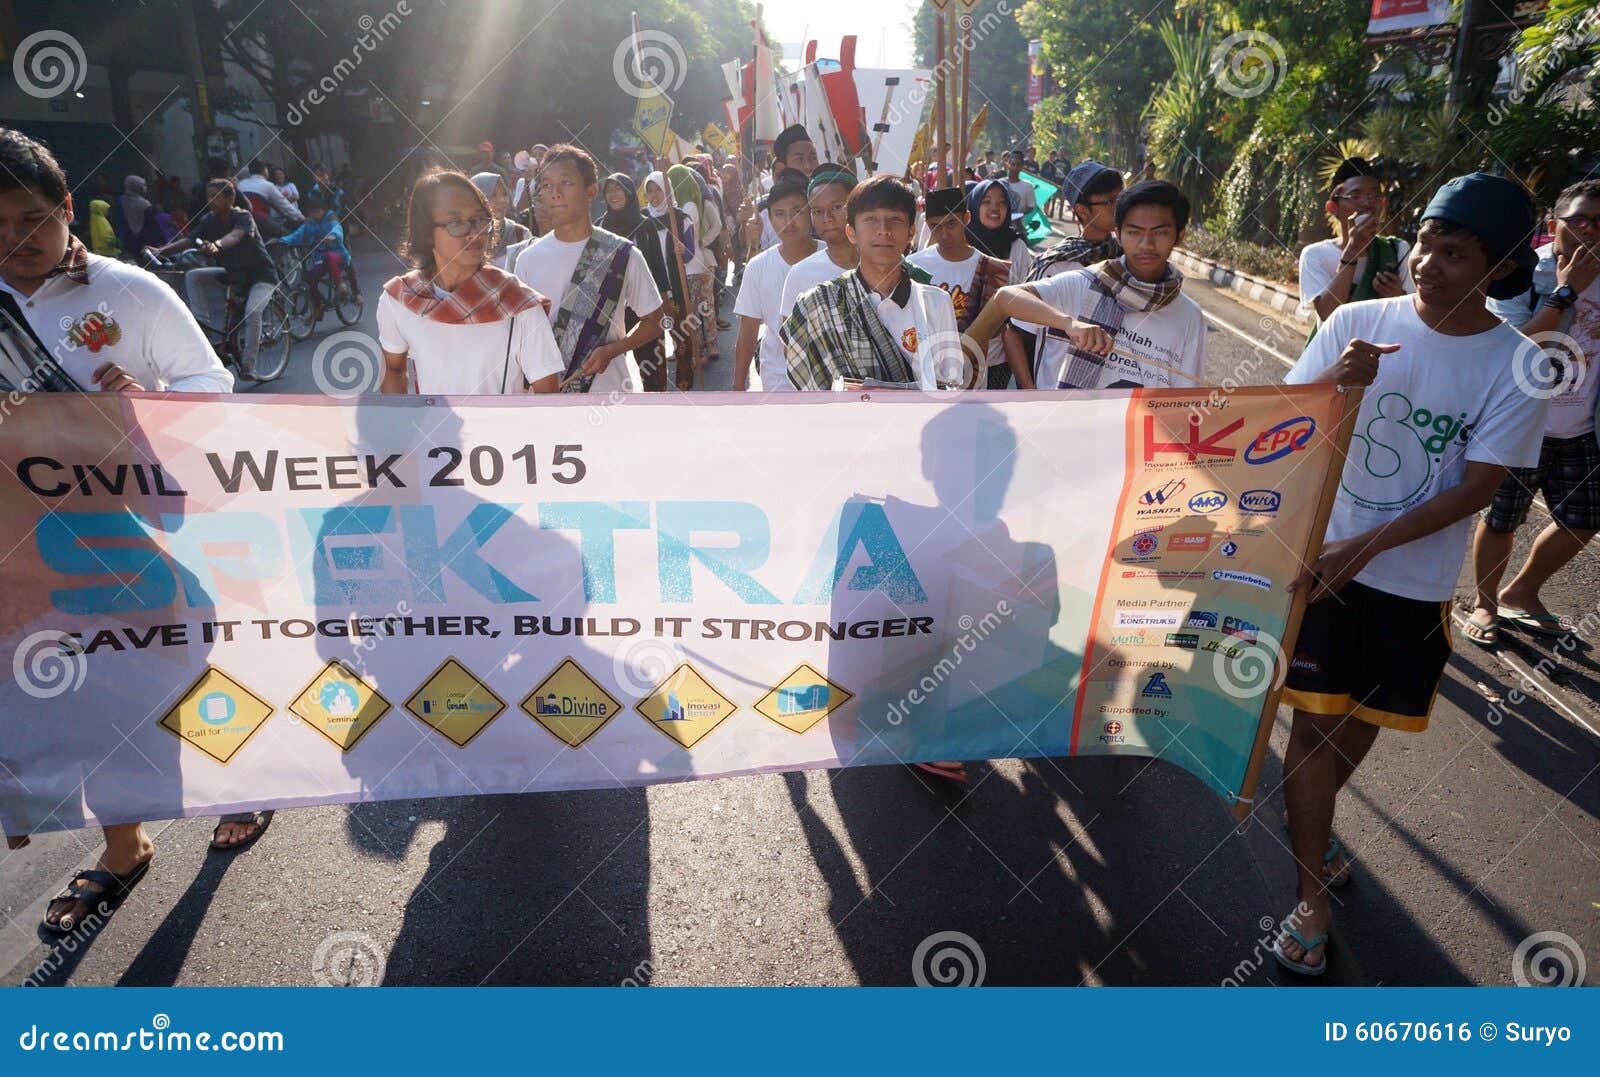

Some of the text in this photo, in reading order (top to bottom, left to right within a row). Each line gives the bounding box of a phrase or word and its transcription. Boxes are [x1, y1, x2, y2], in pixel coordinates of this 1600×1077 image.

[1147, 400, 1209, 410] Sponsored
[1253, 428, 1311, 452] EPC
[16, 444, 587, 497] CIVIL WEEK 2015
[1136, 507, 1181, 516] WASKITA
[35, 501, 929, 615] SPEKTRA
[1116, 599, 1148, 608] Media
[1188, 619, 1209, 628] RRI
[58, 615, 935, 657] SAVE IT TOGETHER, BUILD IT STRONGER
[1108, 659, 1160, 669] Organized
[562, 696, 608, 716] Divine
[687, 702, 721, 710] Inovasi
[1100, 705, 1169, 718] Supported by:
[326, 716, 360, 724] Seminar
[187, 727, 206, 738] Call
[208, 726, 221, 737] for
